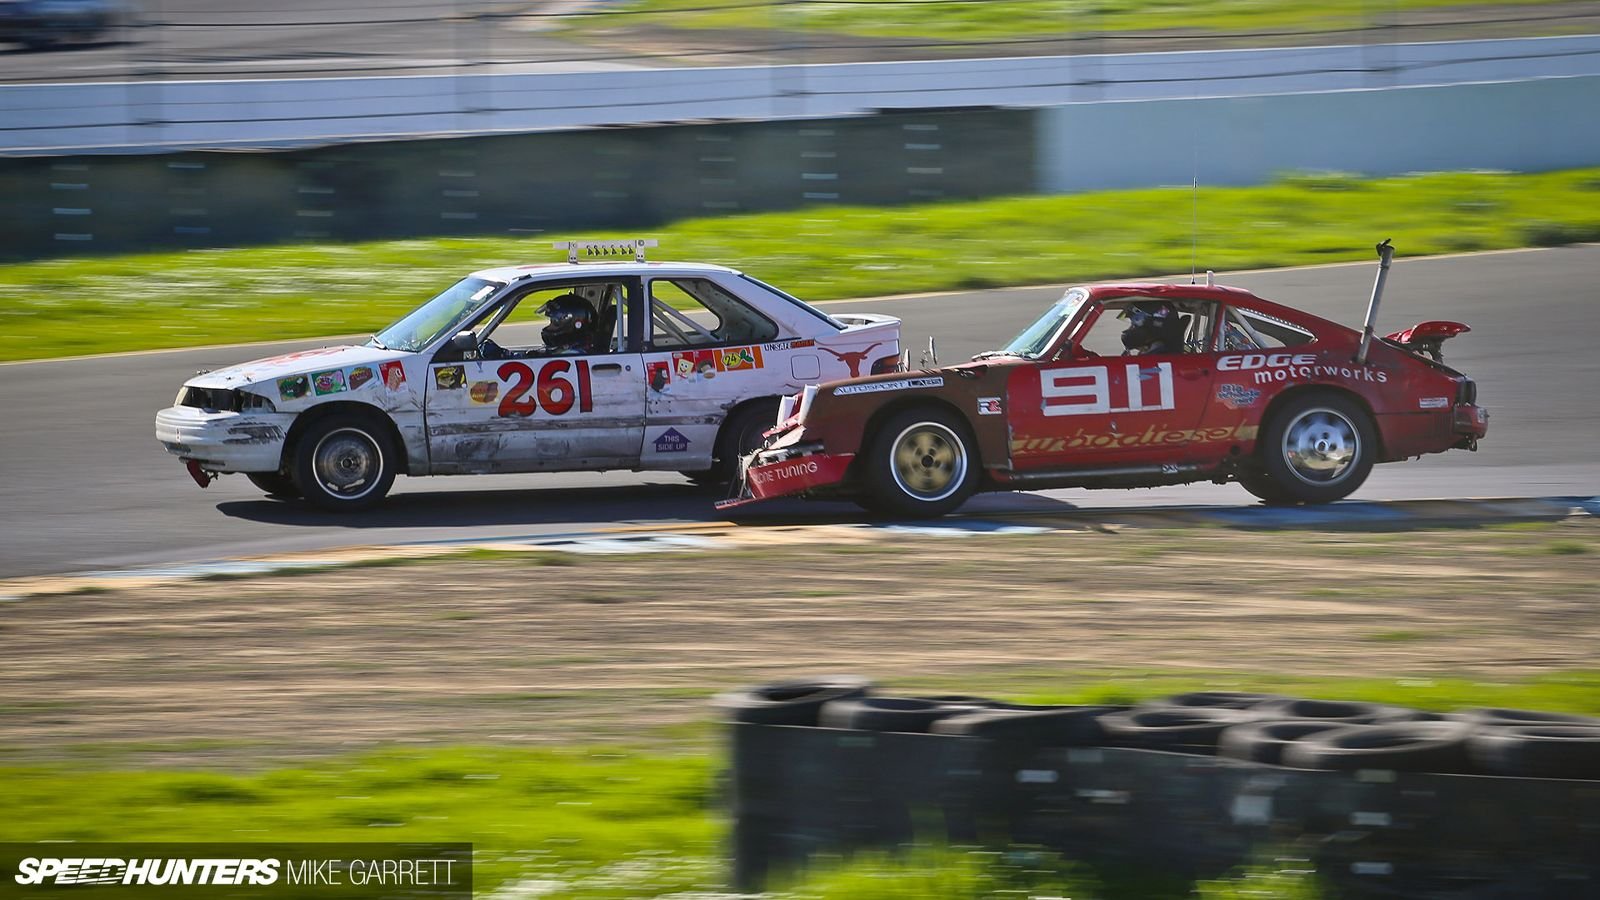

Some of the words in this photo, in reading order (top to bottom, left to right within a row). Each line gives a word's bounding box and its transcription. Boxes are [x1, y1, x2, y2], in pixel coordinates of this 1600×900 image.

[724, 355, 737, 367] 24
[1216, 353, 1318, 372] EDGE
[1254, 364, 1388, 385] motorworks
[496, 359, 593, 418] 261
[1040, 362, 1176, 417] 911
[657, 443, 674, 451] SIDE
[675, 442, 686, 451] UP
[663, 434, 680, 443] THIS
[775, 462, 819, 479] TUNING
